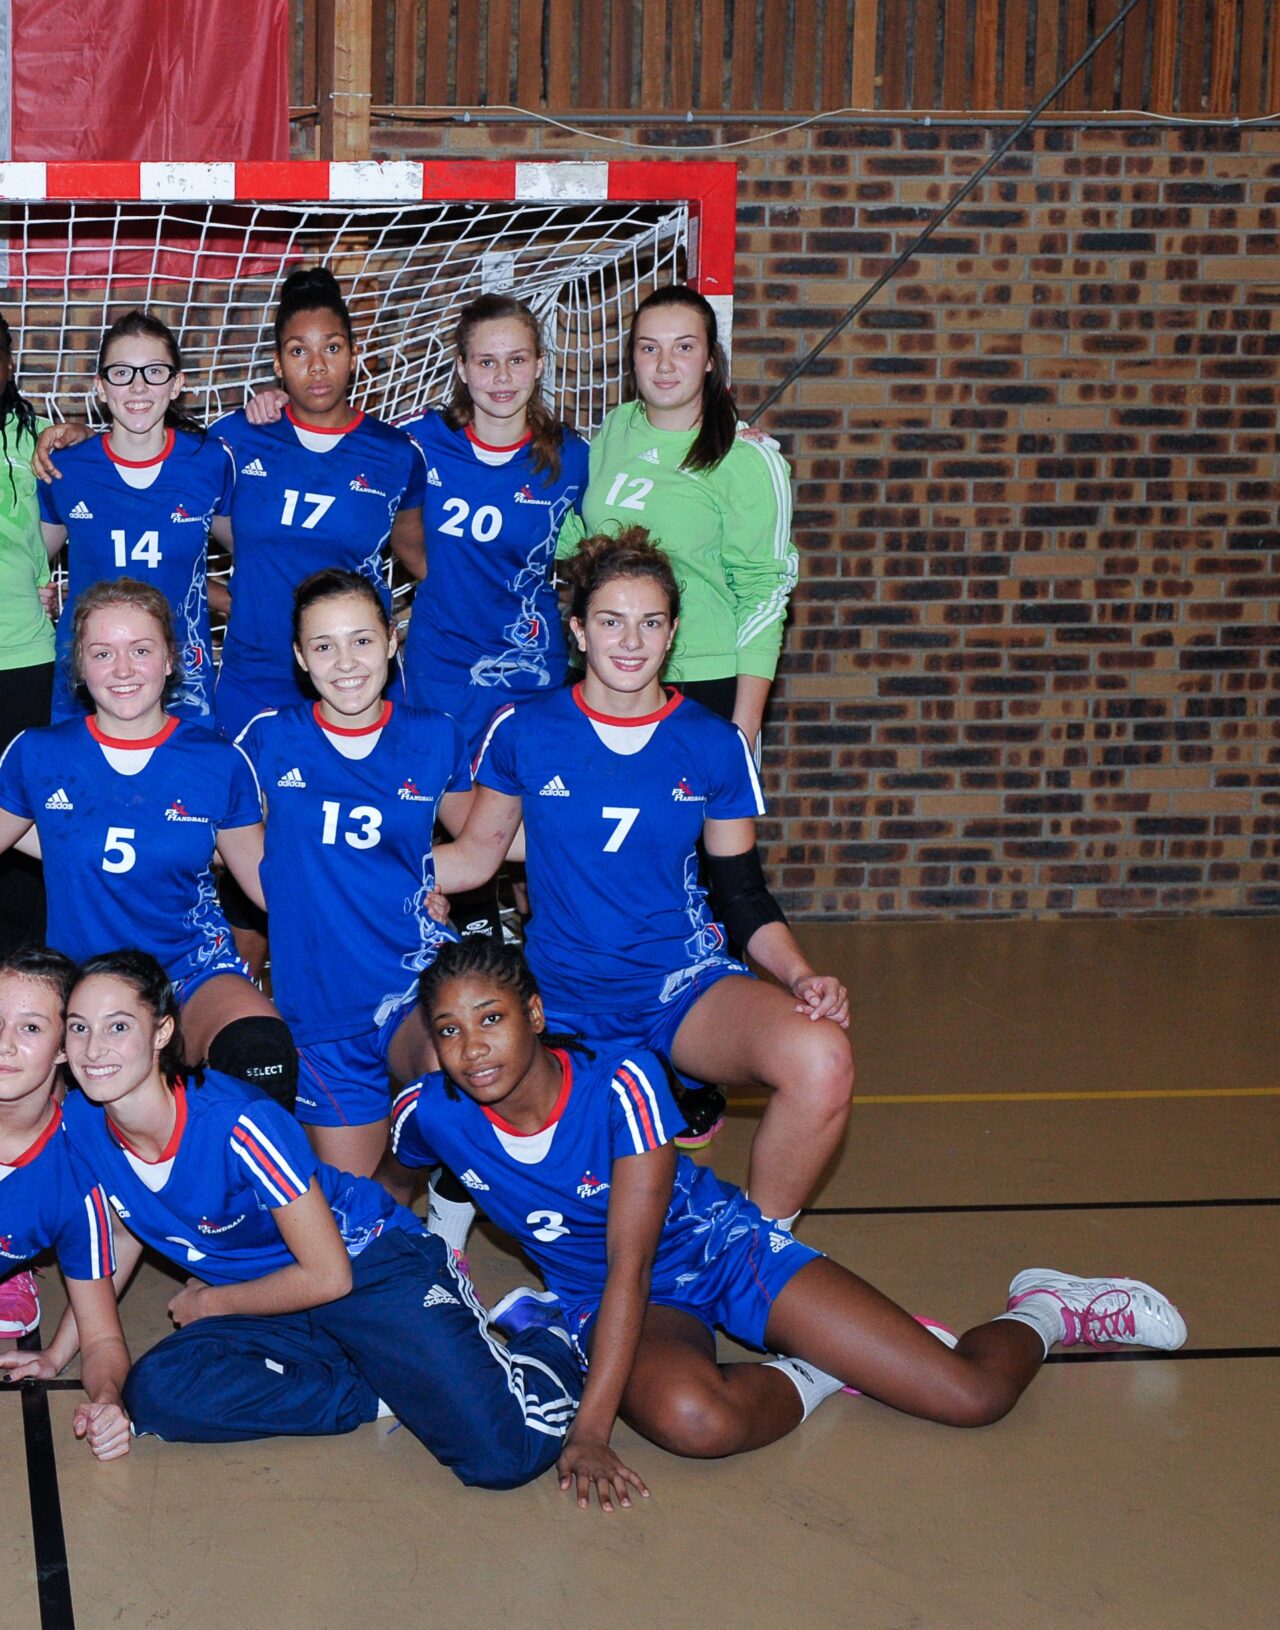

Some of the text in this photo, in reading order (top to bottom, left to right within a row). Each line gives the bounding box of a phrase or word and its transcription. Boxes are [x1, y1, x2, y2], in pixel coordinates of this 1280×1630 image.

[280, 489, 336, 529] 17
[604, 473, 653, 510] 12
[438, 497, 502, 542] 20
[111, 529, 162, 568] 14
[539, 788, 570, 797] adidas
[167, 813, 209, 823] HANDBALL
[322, 800, 383, 850] 13
[601, 806, 640, 853] 7
[102, 826, 136, 874] 5
[246, 1064, 283, 1077] SELECT
[526, 1209, 570, 1242] 3
[423, 1296, 460, 1308] adidas
